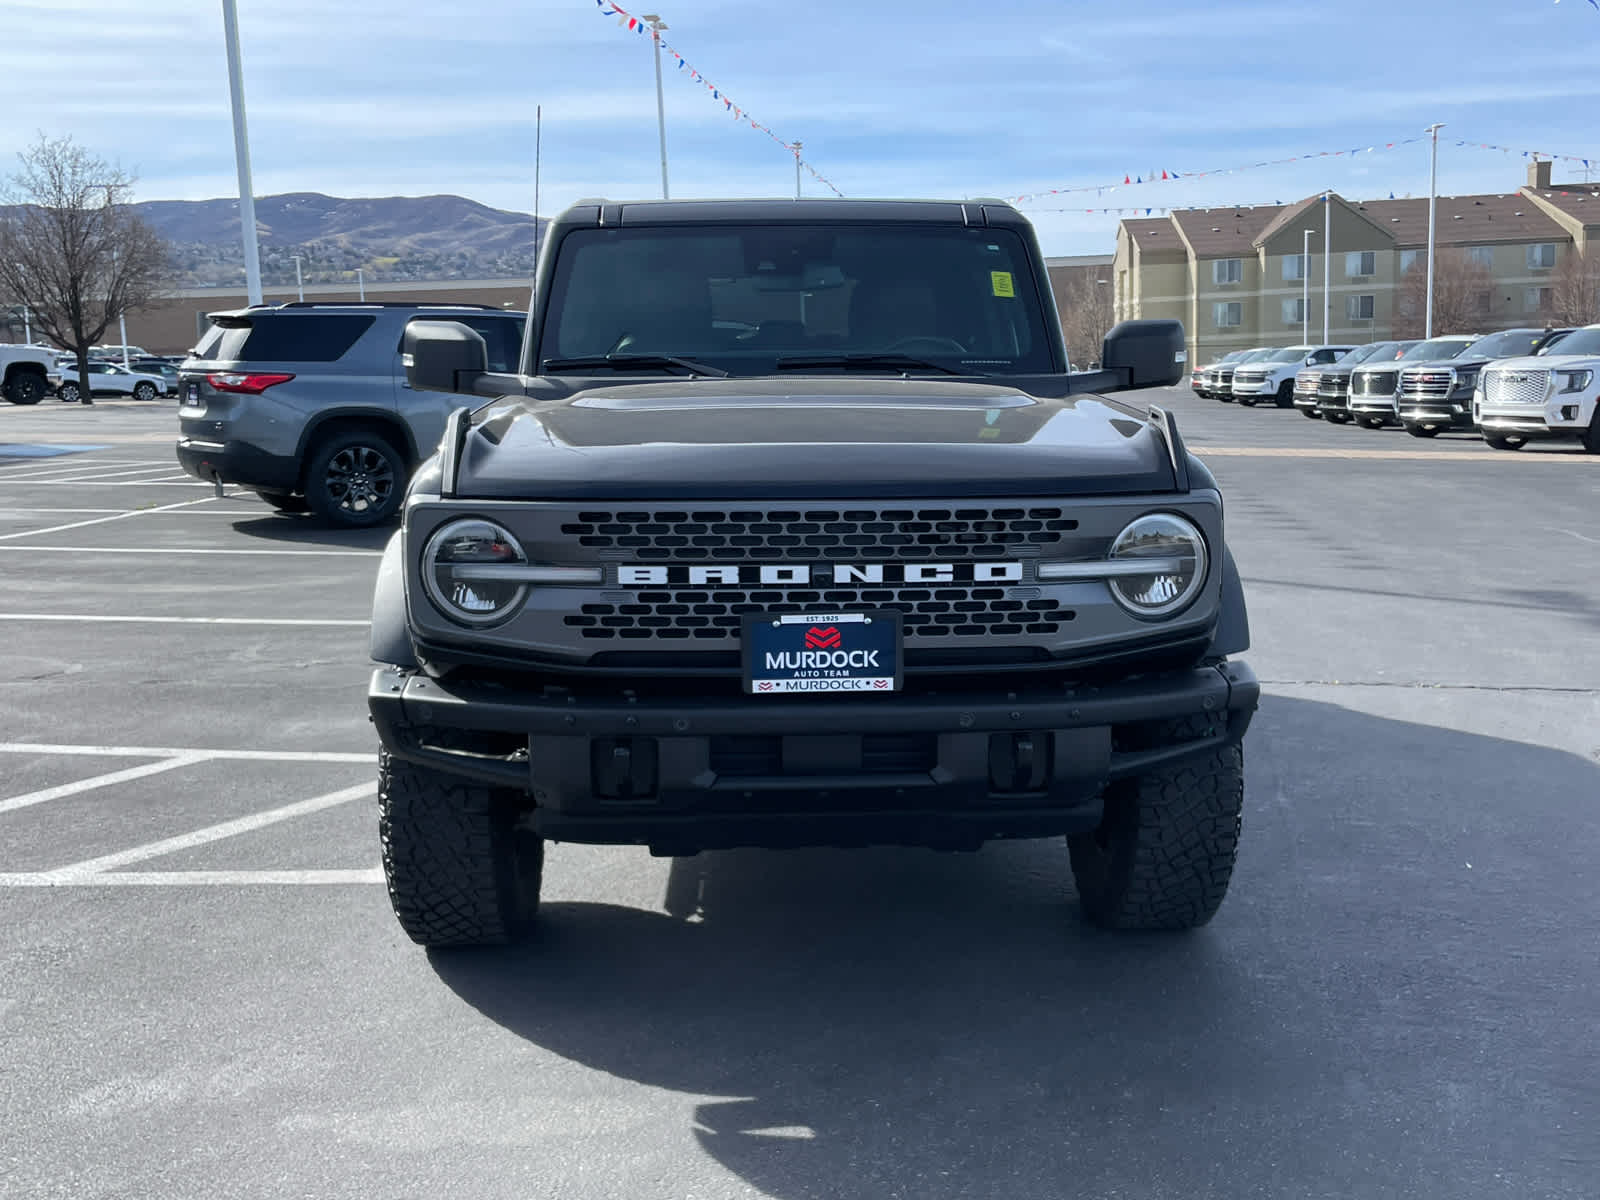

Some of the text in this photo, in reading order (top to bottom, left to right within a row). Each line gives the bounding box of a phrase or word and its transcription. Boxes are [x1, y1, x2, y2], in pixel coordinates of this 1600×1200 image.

[617, 563, 1023, 585] BRONCO
[765, 650, 880, 670] MURDOCK
[793, 669, 850, 678] AUTO TEAM
[785, 680, 861, 690] MURDOCK
